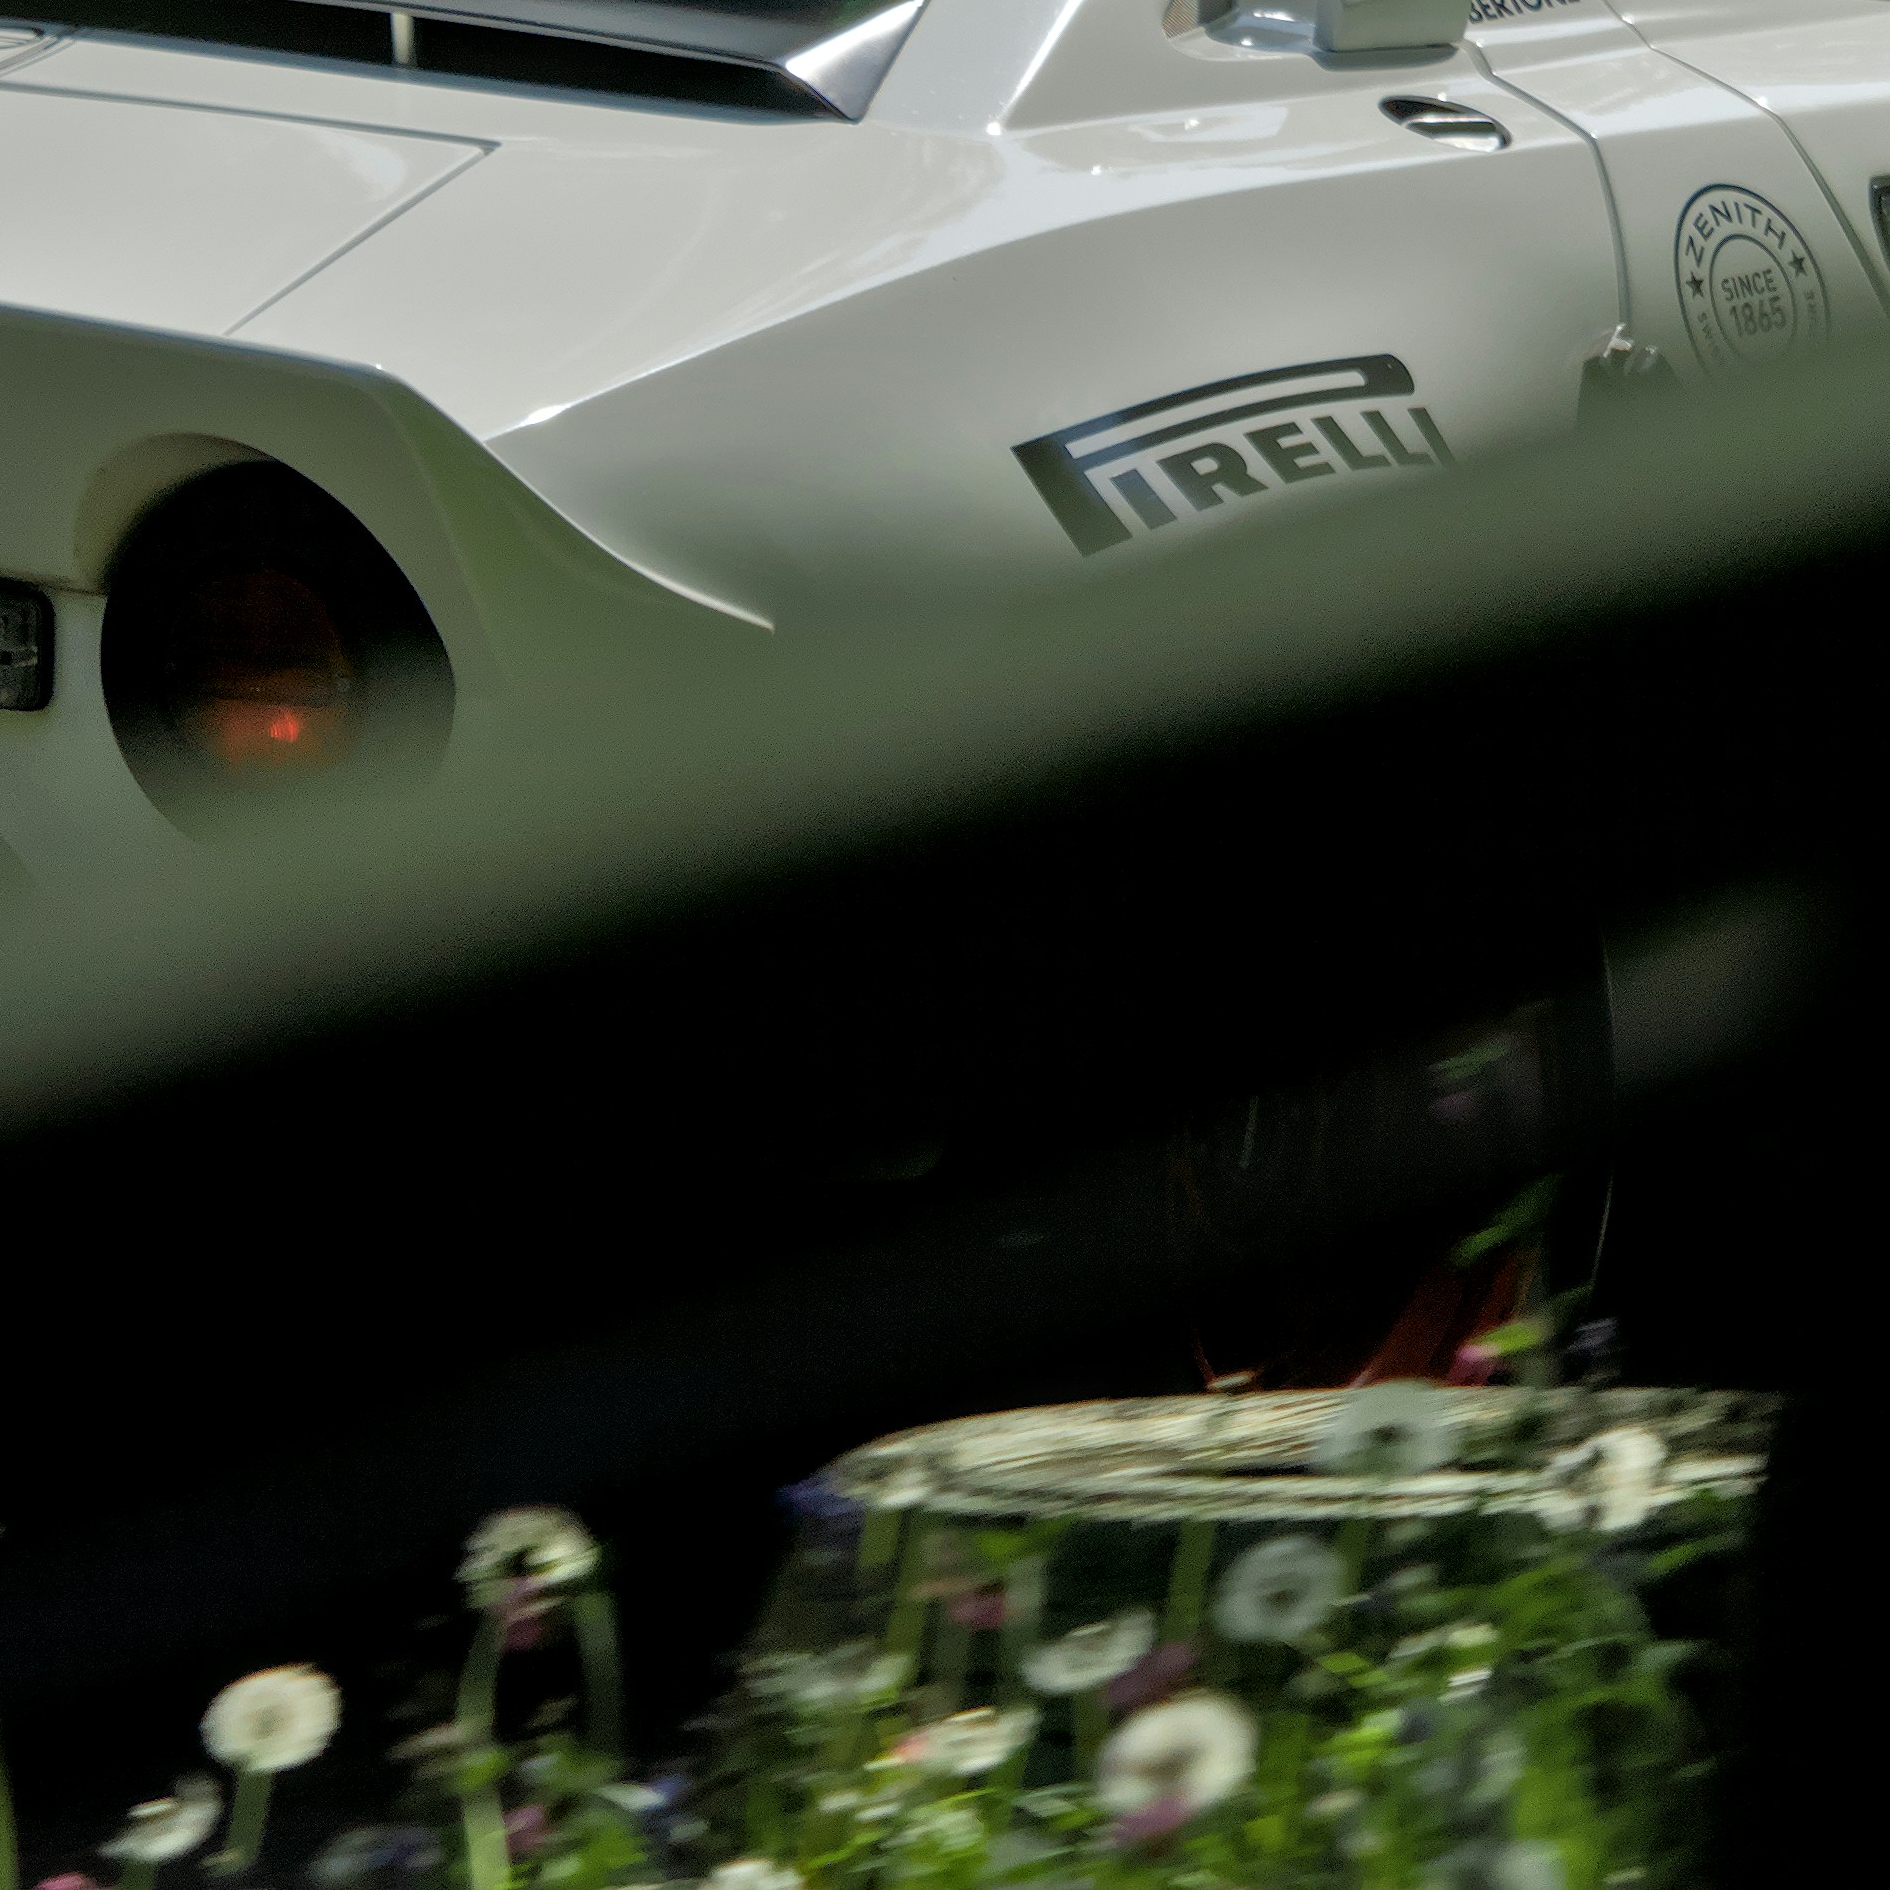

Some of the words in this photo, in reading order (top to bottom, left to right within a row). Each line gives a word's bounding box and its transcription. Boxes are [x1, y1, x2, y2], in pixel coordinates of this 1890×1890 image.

[1684, 200, 1787, 268] ZENITH
[1720, 268, 1778, 302] SINCE
[1729, 295, 1788, 337] 1865
[1009, 353, 1456, 558] PIRELLI
